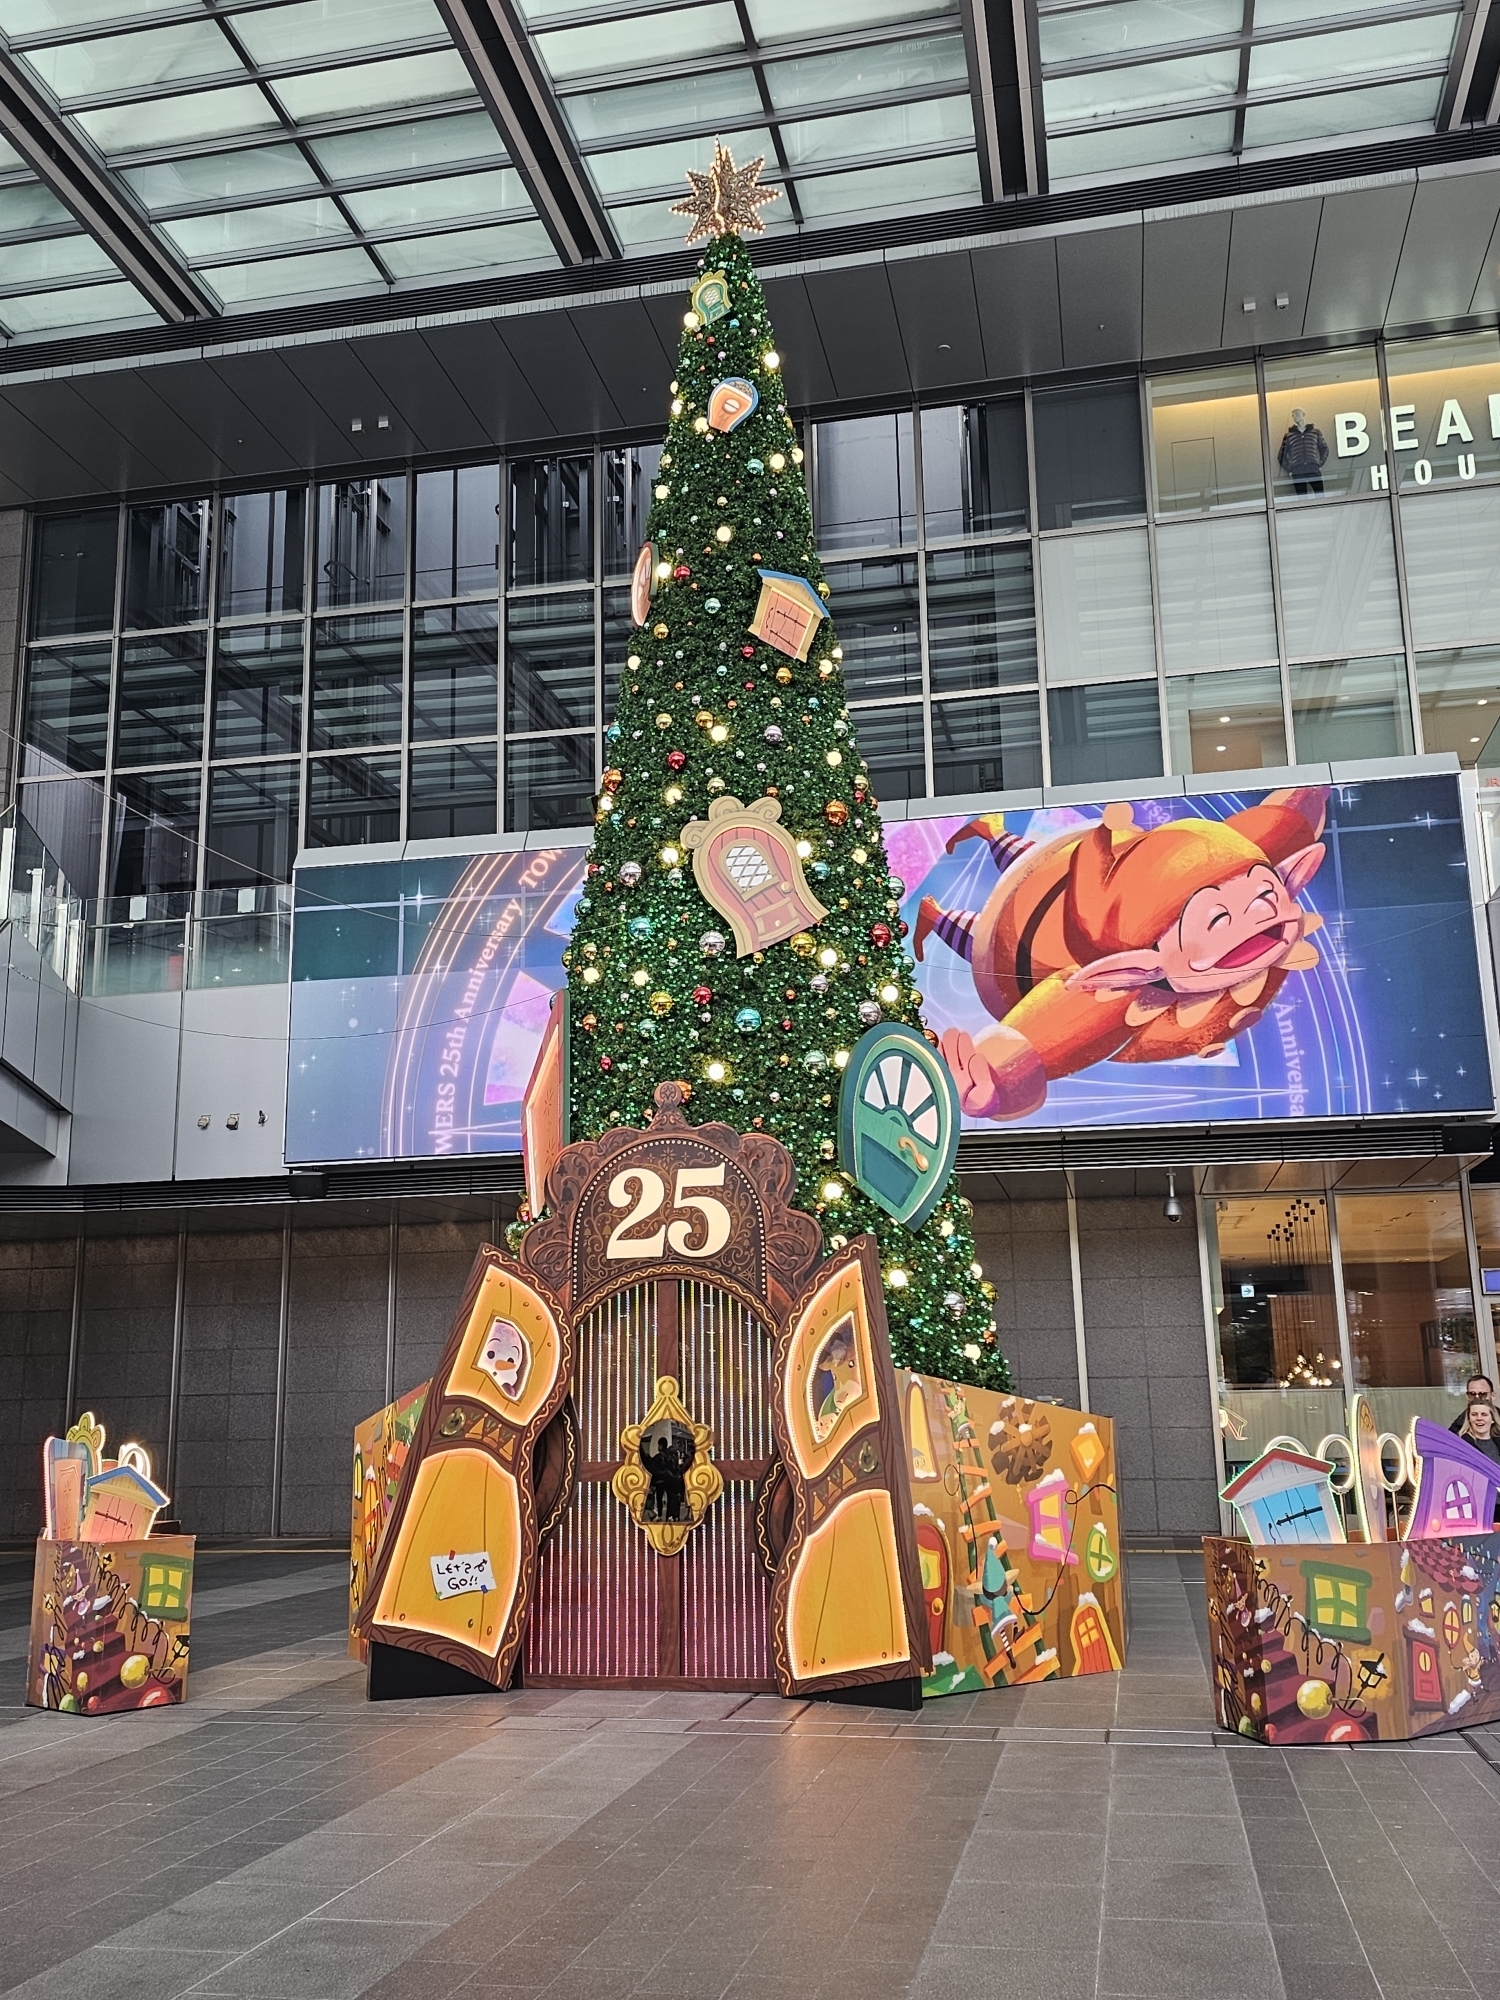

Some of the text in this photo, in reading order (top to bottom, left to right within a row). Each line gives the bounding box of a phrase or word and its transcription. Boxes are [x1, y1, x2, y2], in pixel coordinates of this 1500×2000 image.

[440, 1026, 466, 1077] 25th
[453, 897, 523, 1024] Anniversary
[606, 1162, 731, 1259] 25
